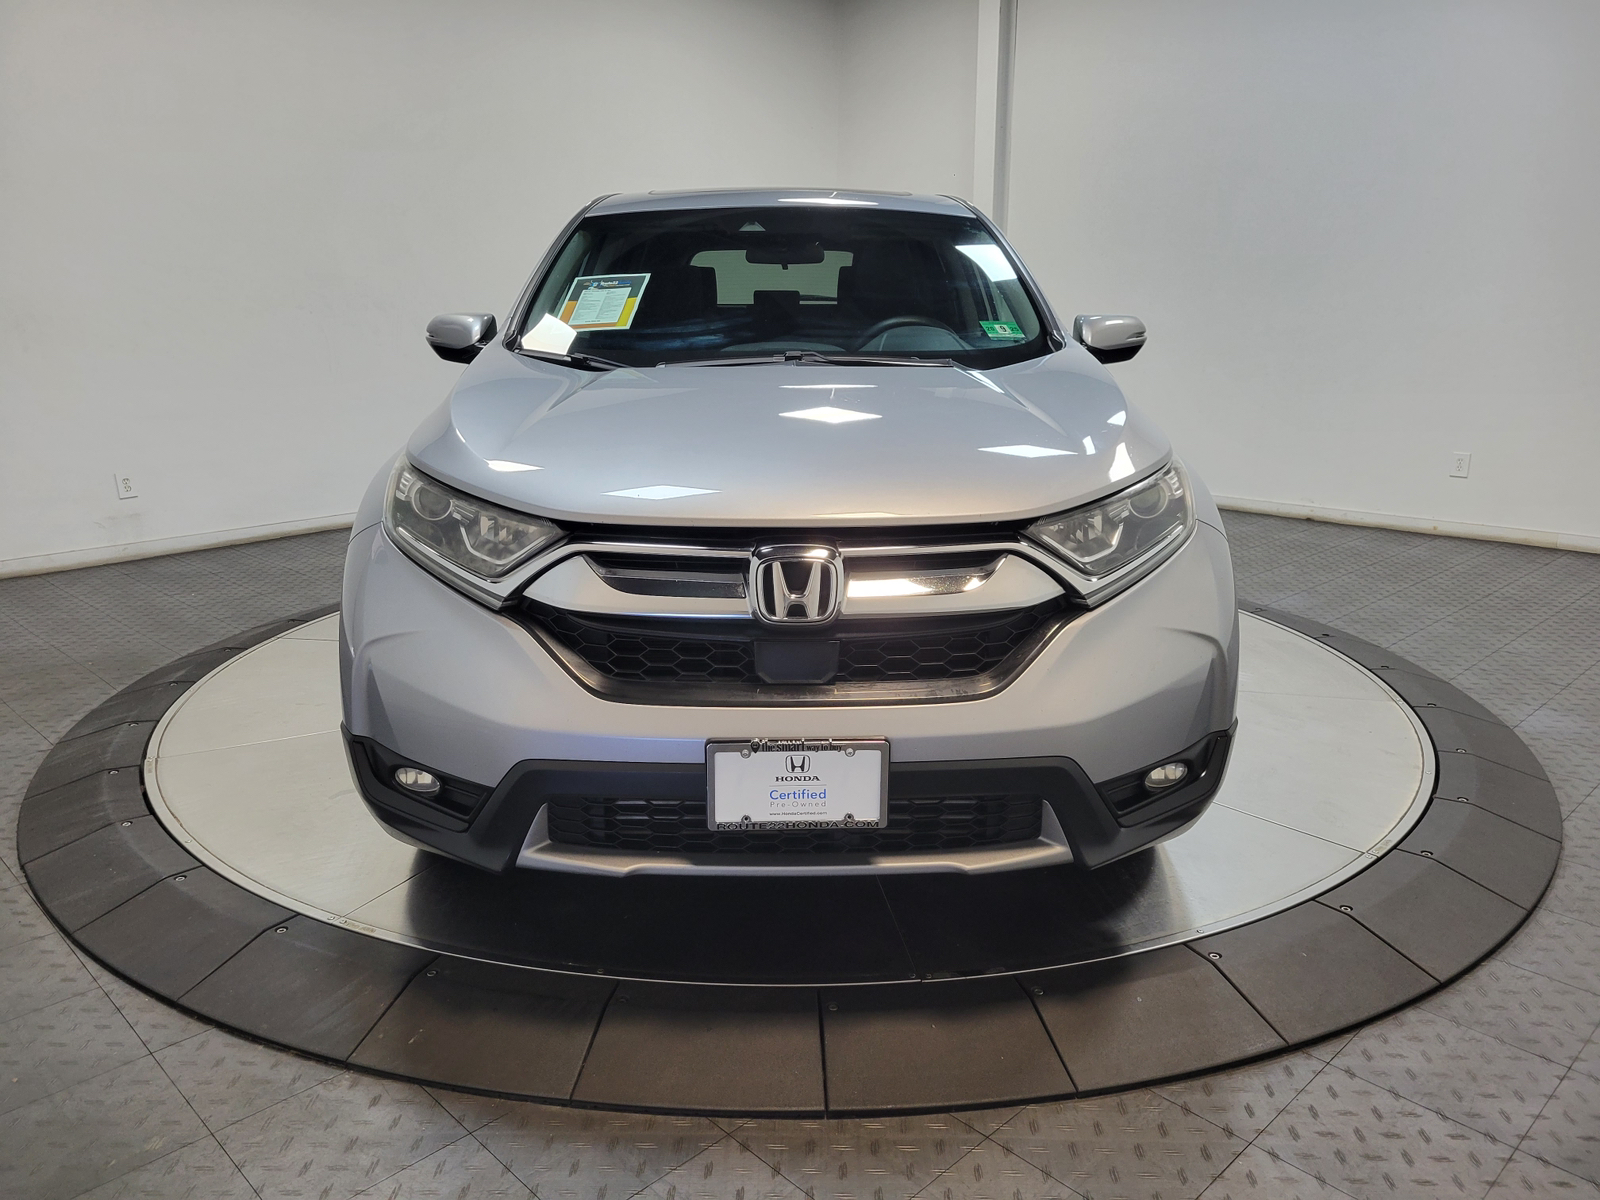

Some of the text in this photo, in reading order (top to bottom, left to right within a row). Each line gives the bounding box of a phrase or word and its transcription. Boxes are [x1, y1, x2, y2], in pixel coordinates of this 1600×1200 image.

[776, 740, 805, 752] smart
[806, 744, 819, 752] way
[821, 743, 828, 751] to
[829, 741, 842, 752] buy
[770, 789, 826, 800] Certified
